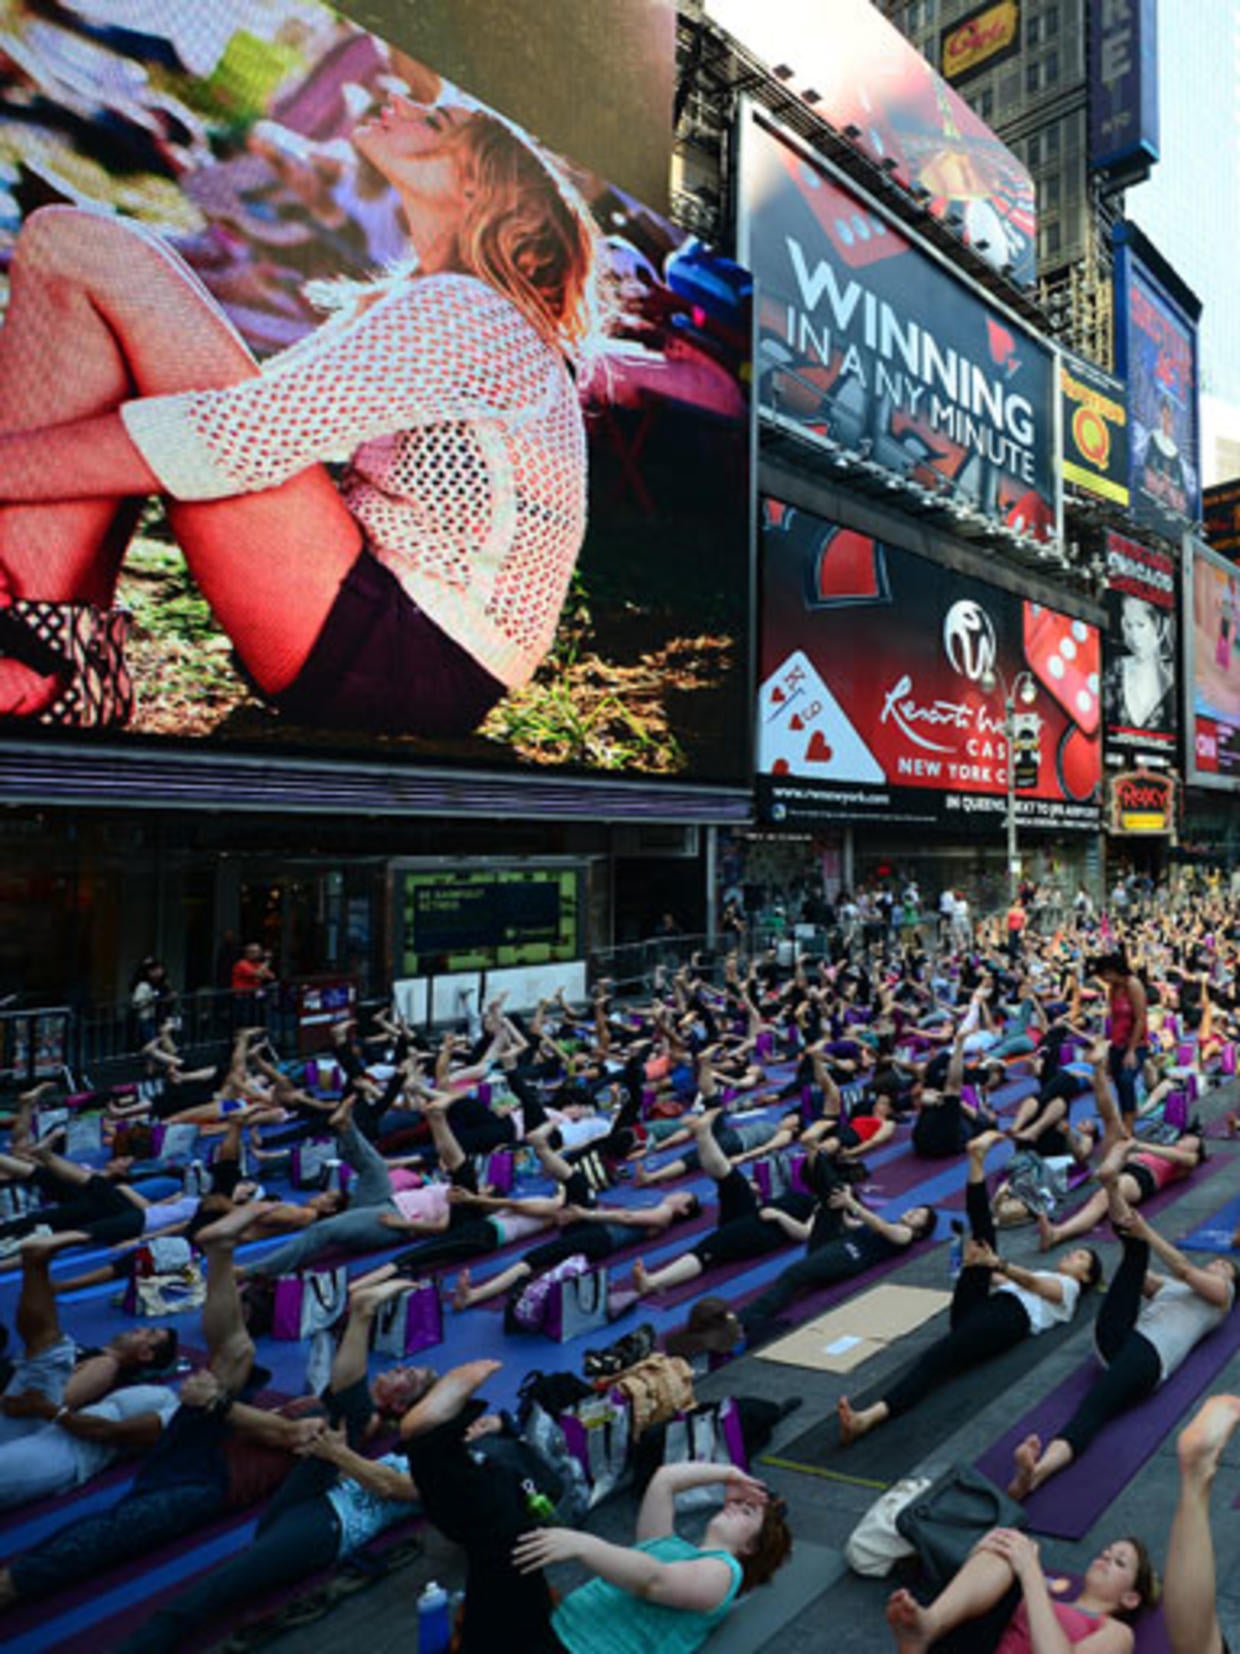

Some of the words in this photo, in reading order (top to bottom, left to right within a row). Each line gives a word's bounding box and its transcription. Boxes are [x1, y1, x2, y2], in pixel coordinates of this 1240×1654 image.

[786, 236, 1035, 446] WINNING
[786, 306, 830, 366] IN
[840, 345, 867, 388] A
[930, 394, 1035, 484] MINUTE
[966, 738, 1007, 760] CAS
[897, 757, 941, 777] NEW
[949, 763, 993, 783] YORK
[946, 795, 960, 809] IN
